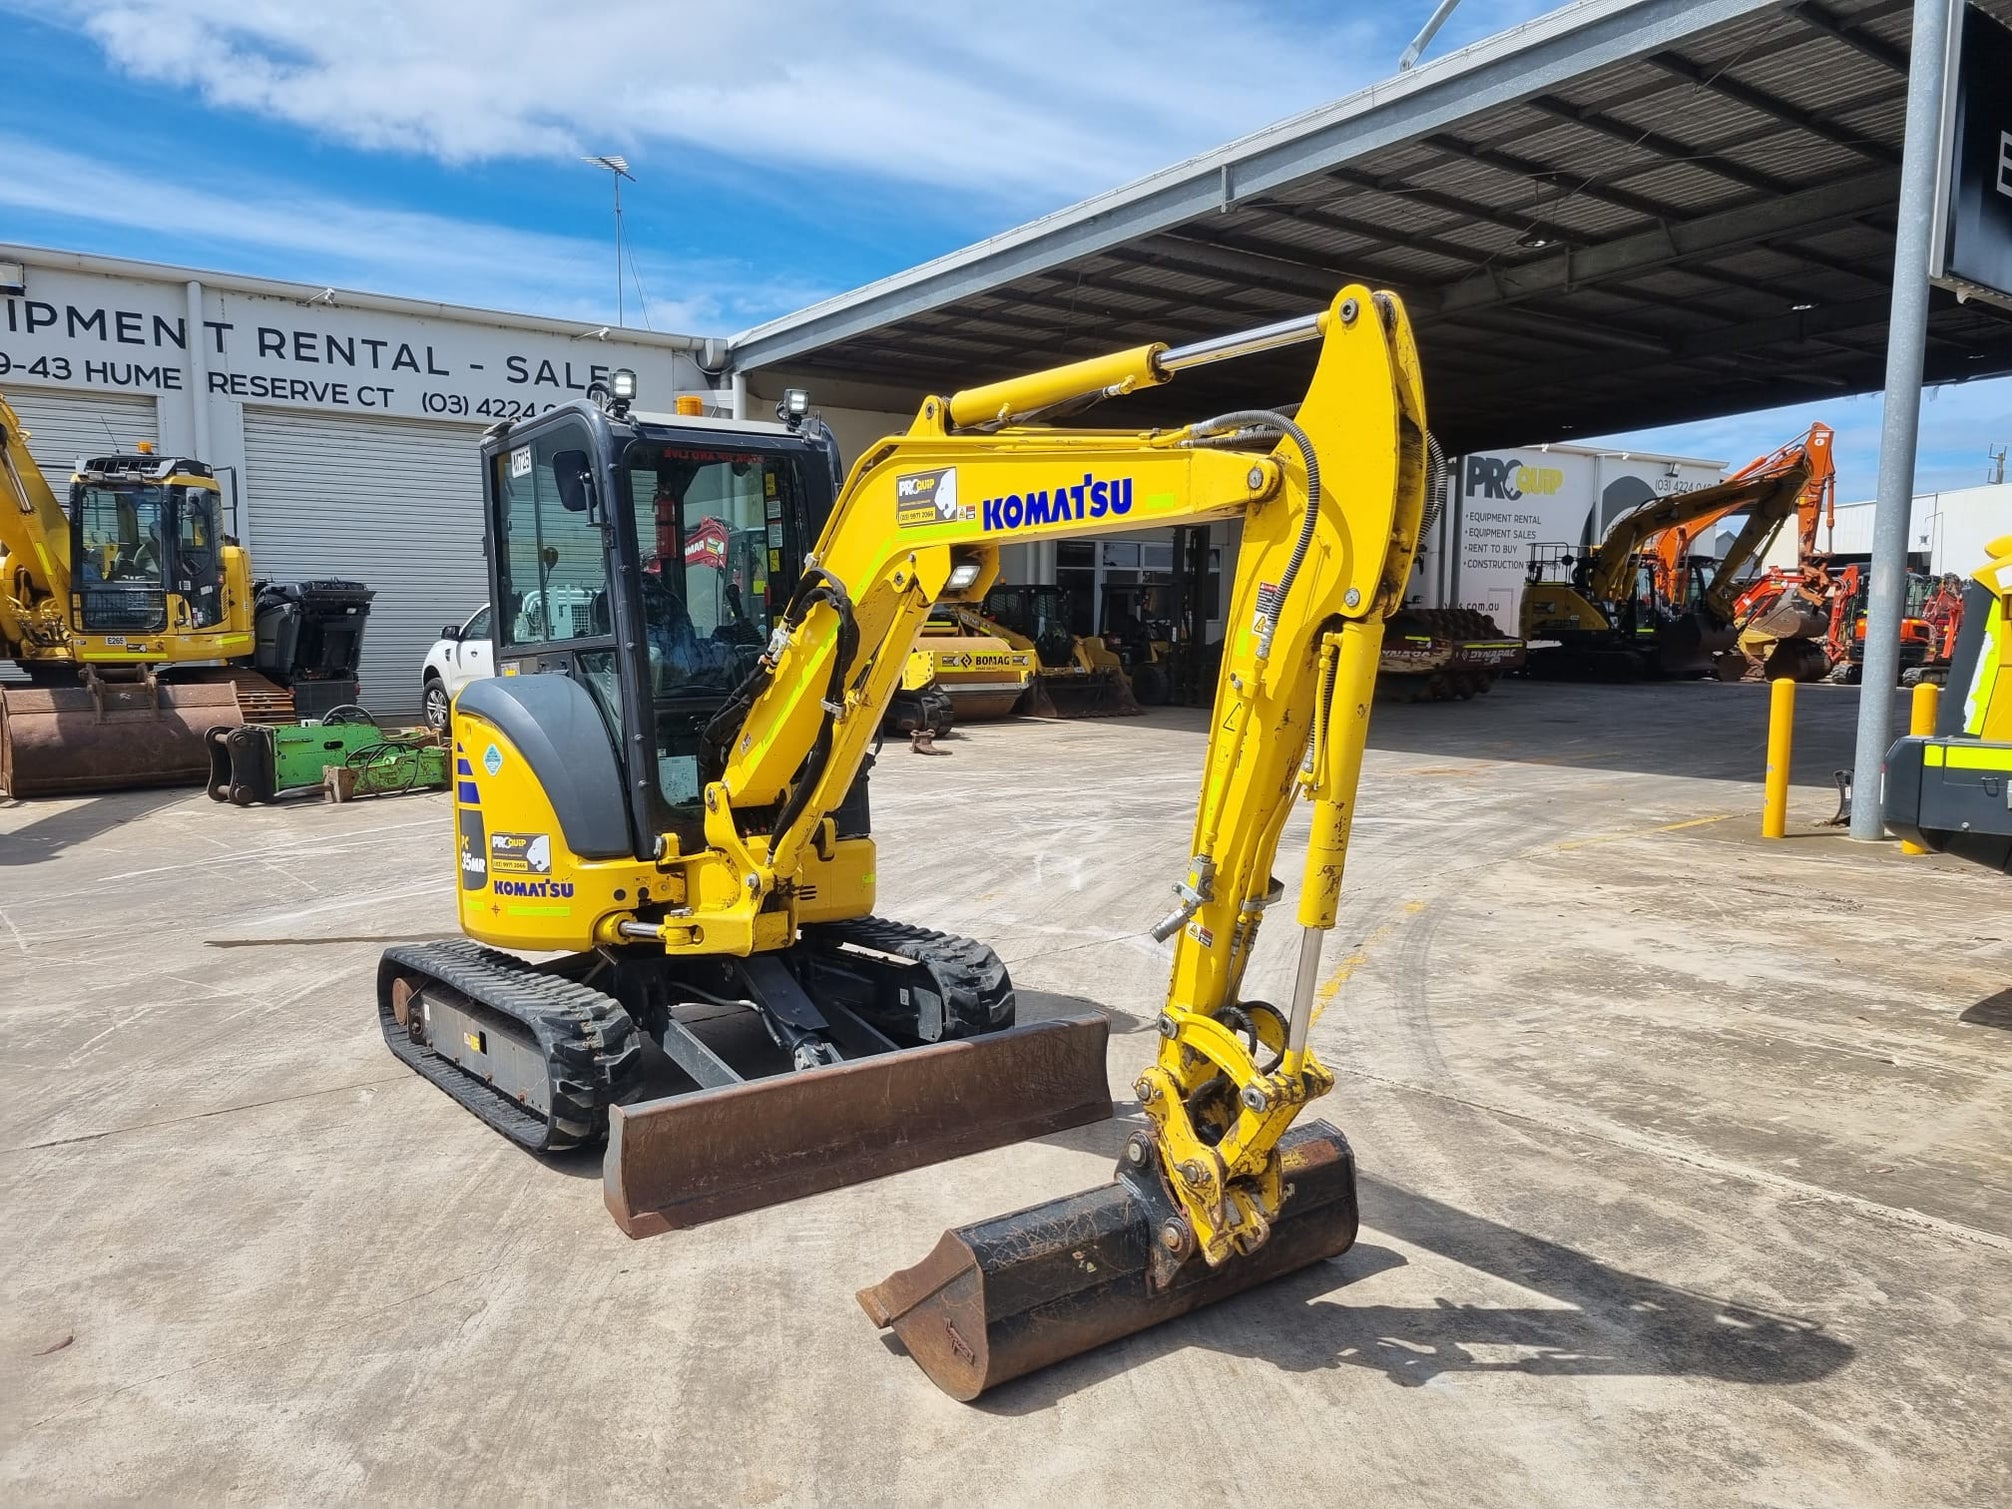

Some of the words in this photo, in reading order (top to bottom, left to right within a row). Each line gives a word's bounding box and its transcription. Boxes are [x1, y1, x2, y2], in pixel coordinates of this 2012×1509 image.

[258, 327, 449, 377] RENTAL
[506, 355, 634, 390] SALE
[85, 360, 182, 390] HUME
[208, 371, 349, 405] RESERVE
[357, 386, 394, 408] CT
[422, 392, 469, 416] (03)
[476, 398, 536, 419] 4224
[1655, 479, 1671, 491] (03)
[1674, 480, 1693, 491] 4224
[983, 473, 1133, 531] KOMATSU
[1469, 512, 1512, 523] EQUIPMENT
[1514, 515, 1541, 524] RENTAL
[1469, 528, 1511, 538] EQUIPMENT
[1513, 530, 1536, 539] SALES
[1468, 544, 1488, 553] RENT
[1491, 544, 1500, 553] TO
[1503, 545, 1517, 554] BUY
[1467, 559, 1524, 569] CONSTRUCTION
[976, 656, 1010, 665] BOMAG
[461, 851, 486, 873] 35MR
[494, 878, 574, 898] KOMATSU
